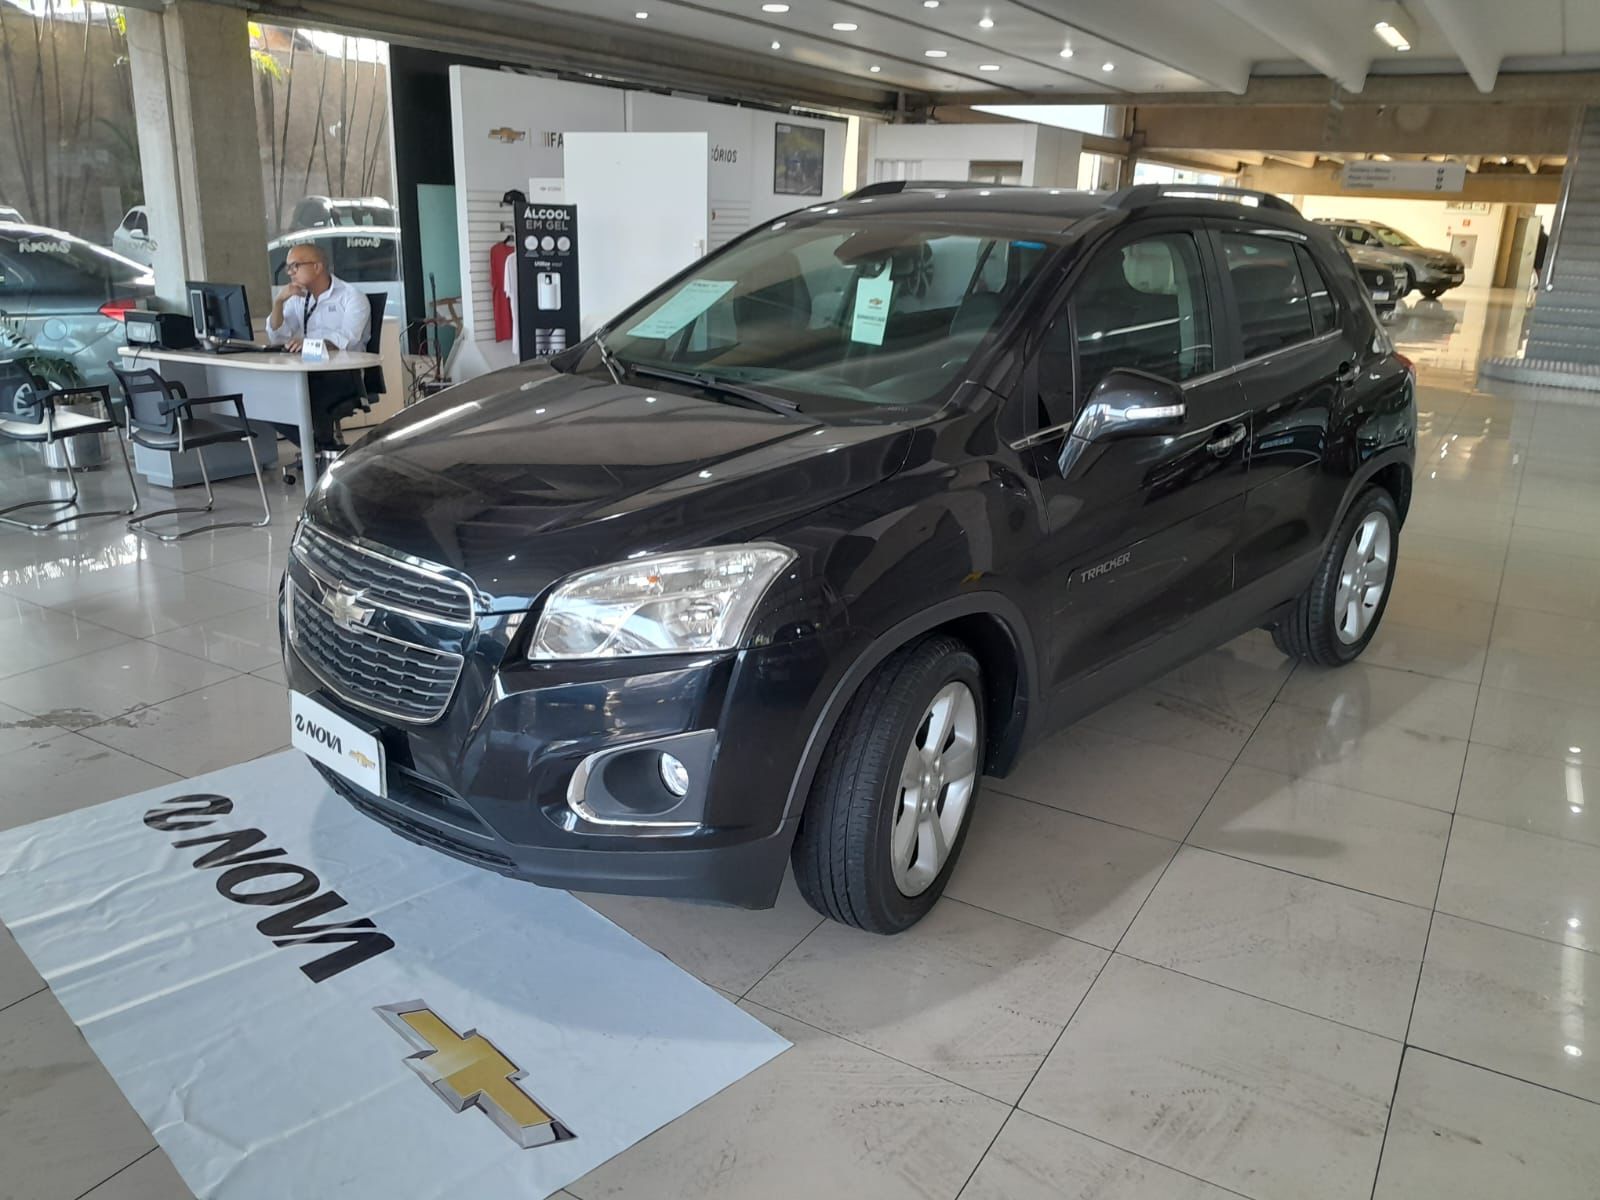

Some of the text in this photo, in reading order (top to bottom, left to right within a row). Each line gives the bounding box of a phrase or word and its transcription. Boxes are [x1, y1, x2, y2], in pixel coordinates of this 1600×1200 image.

[711, 144, 738, 163] ÓRIOS
[526, 220, 569, 231] EM GEL
[1081, 552, 1131, 583] TRACKER
